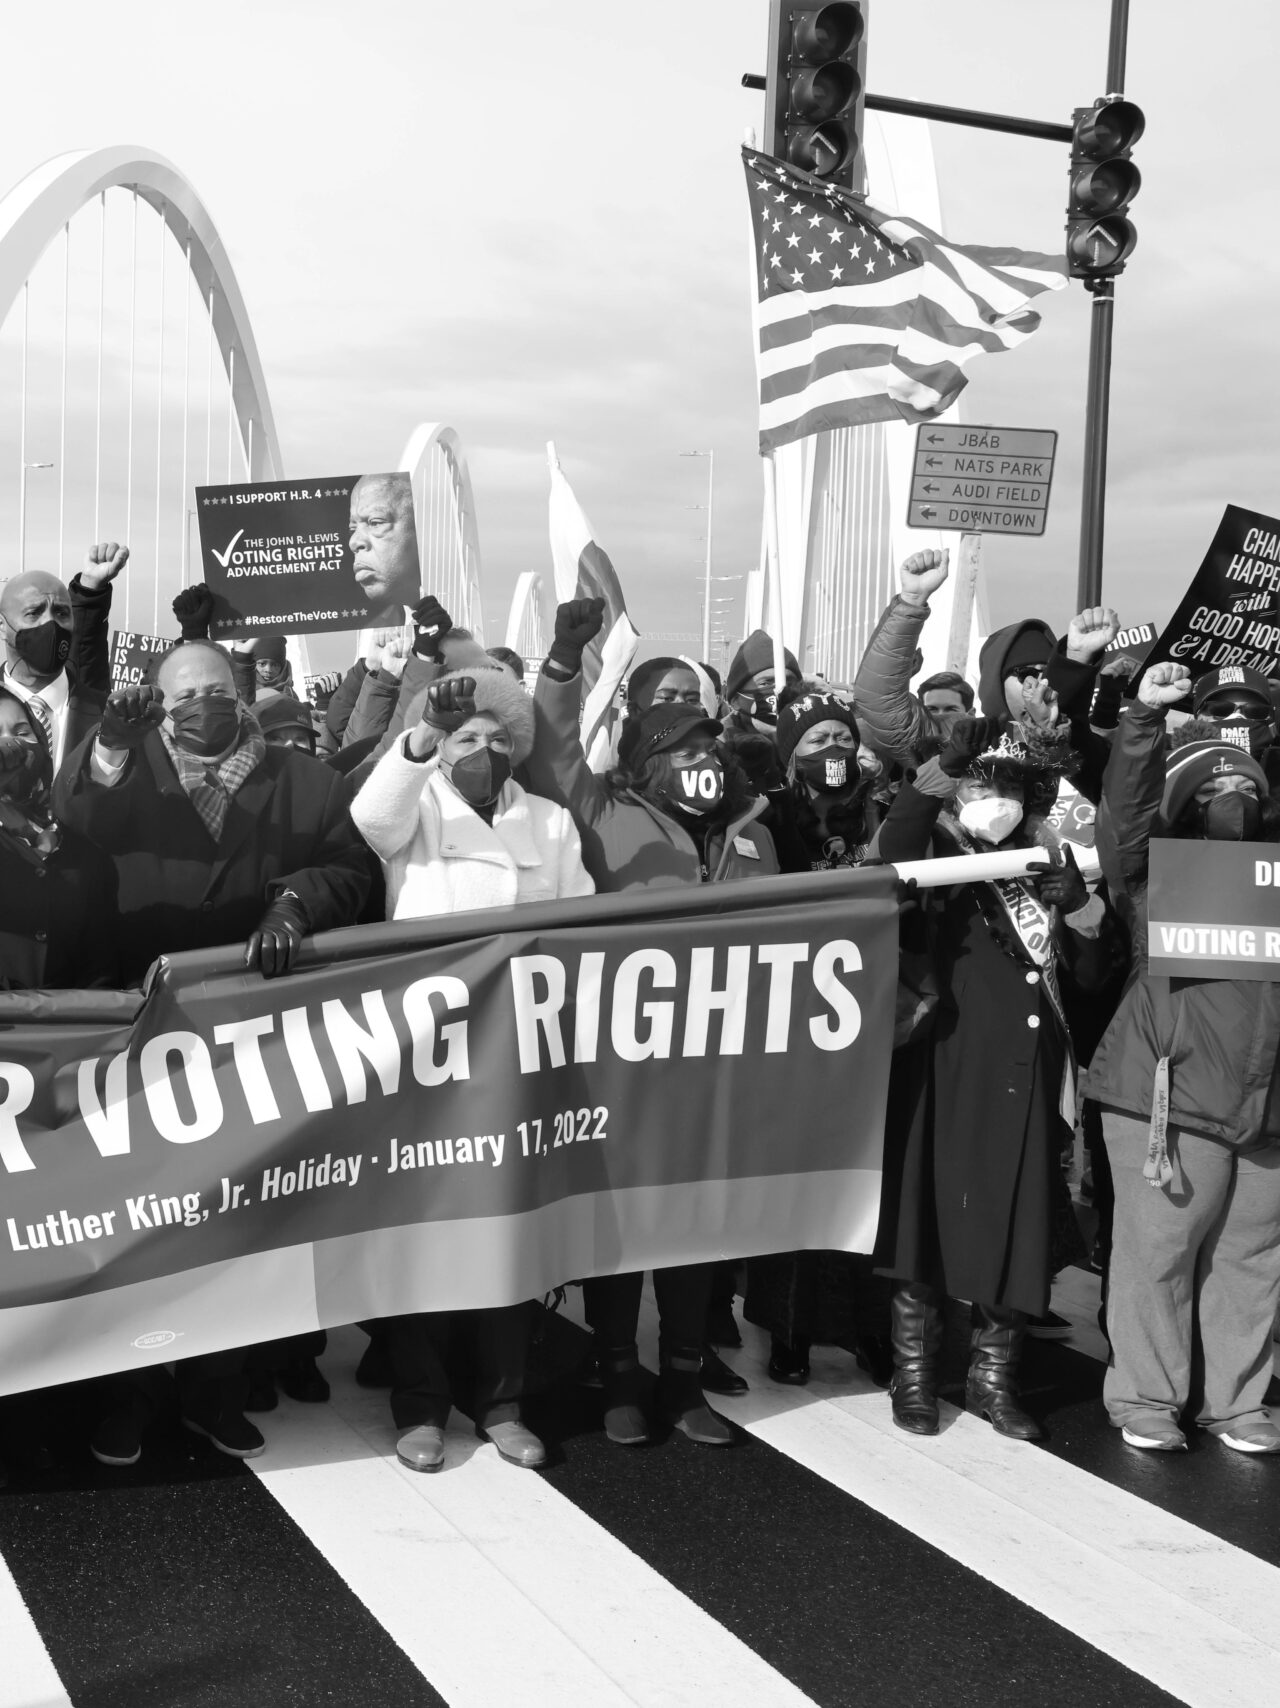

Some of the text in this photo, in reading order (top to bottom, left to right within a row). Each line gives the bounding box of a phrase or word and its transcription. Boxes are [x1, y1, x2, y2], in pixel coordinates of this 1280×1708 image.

[959, 433, 1000, 448] JBAB
[954, 458, 1044, 476] NATS PARK
[229, 489, 322, 505] I SUPPORT H.R. 4
[952, 484, 1041, 502] AUDI FIELD
[948, 509, 1036, 527] DOWNTOWN
[244, 533, 340, 549] THE JOHN R. LEWIS
[287, 544, 344, 561] RIGHTS
[226, 559, 342, 578] ADVANCEMENT ACT
[1225, 554, 1280, 593] HAPPE
[1232, 590, 1271, 613] with
[245, 610, 339, 626] #RestoreTheVote
[1189, 606, 1244, 640] GOOD
[117, 632, 135, 649] DC
[114, 648, 128, 664] IS
[1192, 638, 1213, 662] A
[1160, 926, 1256, 957] VOTING
[77, 975, 470, 1158] VOTING
[510, 939, 862, 1074] RIGHTS
[7, 1207, 116, 1252] Luther
[125, 1187, 210, 1231] King,
[218, 1176, 251, 1215] Jr.
[261, 1152, 362, 1201] Holiday
[387, 1131, 506, 1175] January
[516, 1121, 549, 1160] 17,
[552, 1105, 608, 1149] 2022
